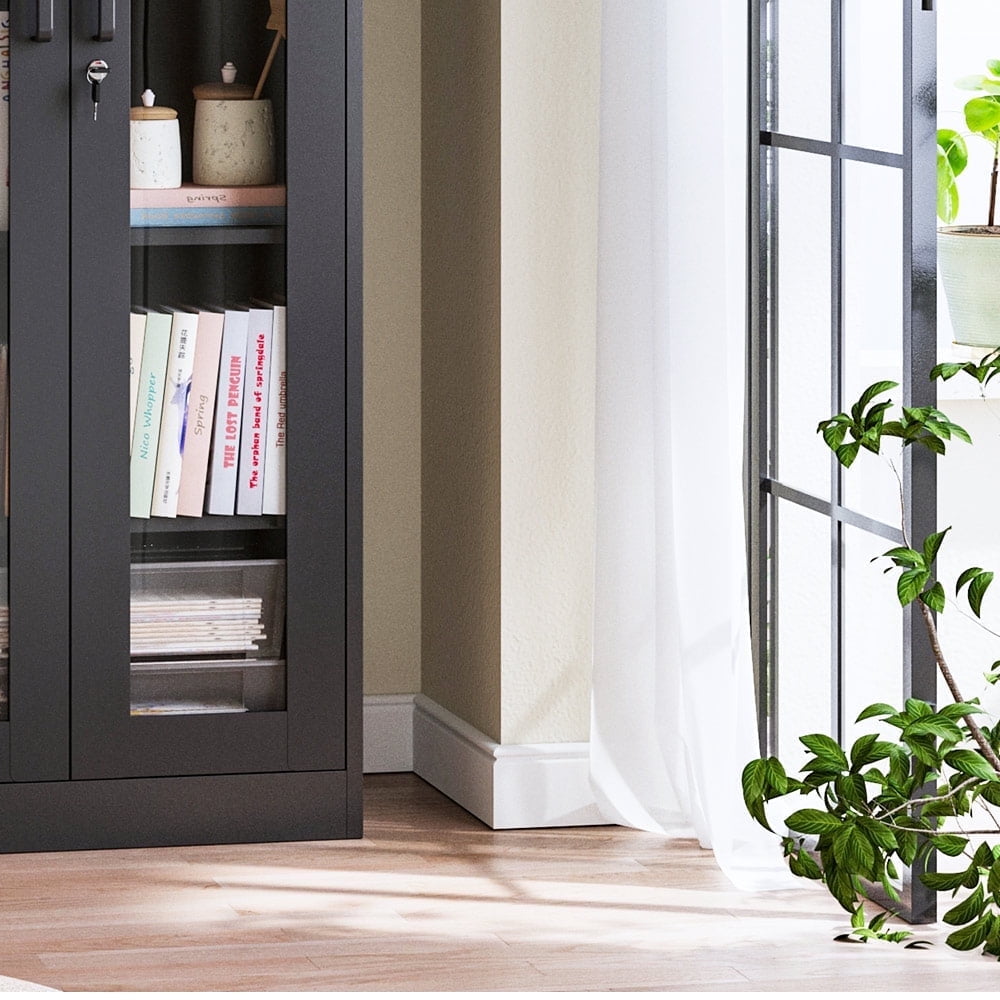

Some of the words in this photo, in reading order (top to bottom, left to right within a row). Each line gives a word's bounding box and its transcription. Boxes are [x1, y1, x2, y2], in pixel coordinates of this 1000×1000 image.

[227, 355, 242, 408] PENGUIN
[143, 371, 158, 429] Whopper
[253, 391, 263, 403] of
[194, 394, 209, 436] Spring
[225, 411, 239, 441] LOST
[252, 405, 261, 429] band
[276, 411, 286, 429] Red
[140, 433, 150, 460] Nico
[252, 432, 261, 467] orphan
[276, 432, 285, 448] The
[223, 444, 236, 469] THE
[249, 469, 259, 489] The
